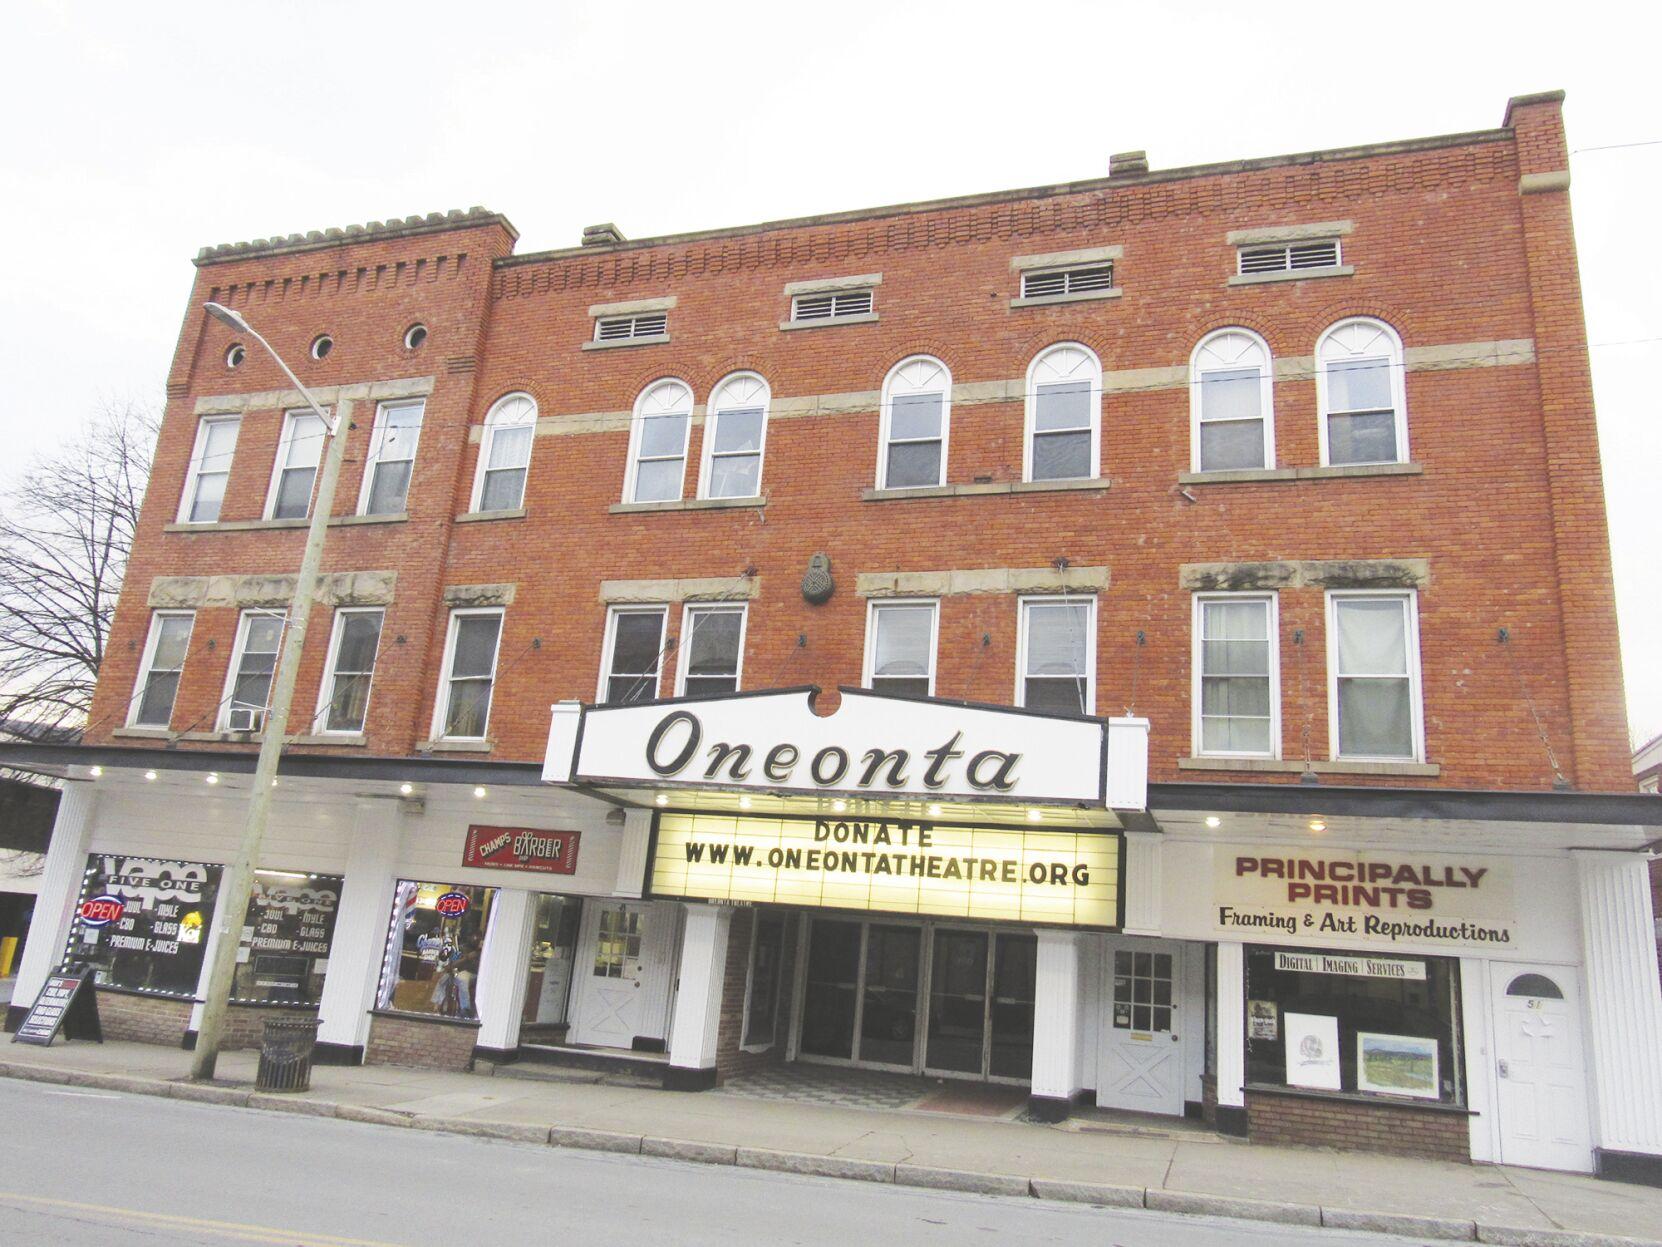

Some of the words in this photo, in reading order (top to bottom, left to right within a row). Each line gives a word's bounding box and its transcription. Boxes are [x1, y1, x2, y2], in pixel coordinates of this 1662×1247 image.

[645, 710, 1023, 791] Oneonta
[480, 832, 511, 857] CHAMPS
[513, 832, 561, 858] BARBER
[814, 821, 933, 847] DONATE
[685, 842, 1090, 886] WWW.ONEONTATHEATRE.ORG
[1236, 857, 1488, 888] PRINCIPALLY
[108, 875, 151, 887] FIVE
[160, 879, 200, 891] ONE
[1288, 883, 1433, 909] PRINTS
[81, 902, 121, 920] OPEN
[437, 899, 467, 912] OPEN
[1219, 907, 1297, 934] Framing
[1303, 913, 1314, 927] &
[1320, 913, 1357, 933] Art
[1364, 914, 1510, 943] Reproductions
[145, 938, 179, 954] E-JUICES
[292, 940, 328, 953] E-JUICES
[1279, 953, 1313, 971] DIGITAL
[1322, 956, 1358, 974] IMAGING
[1366, 959, 1405, 977] SERVICES
